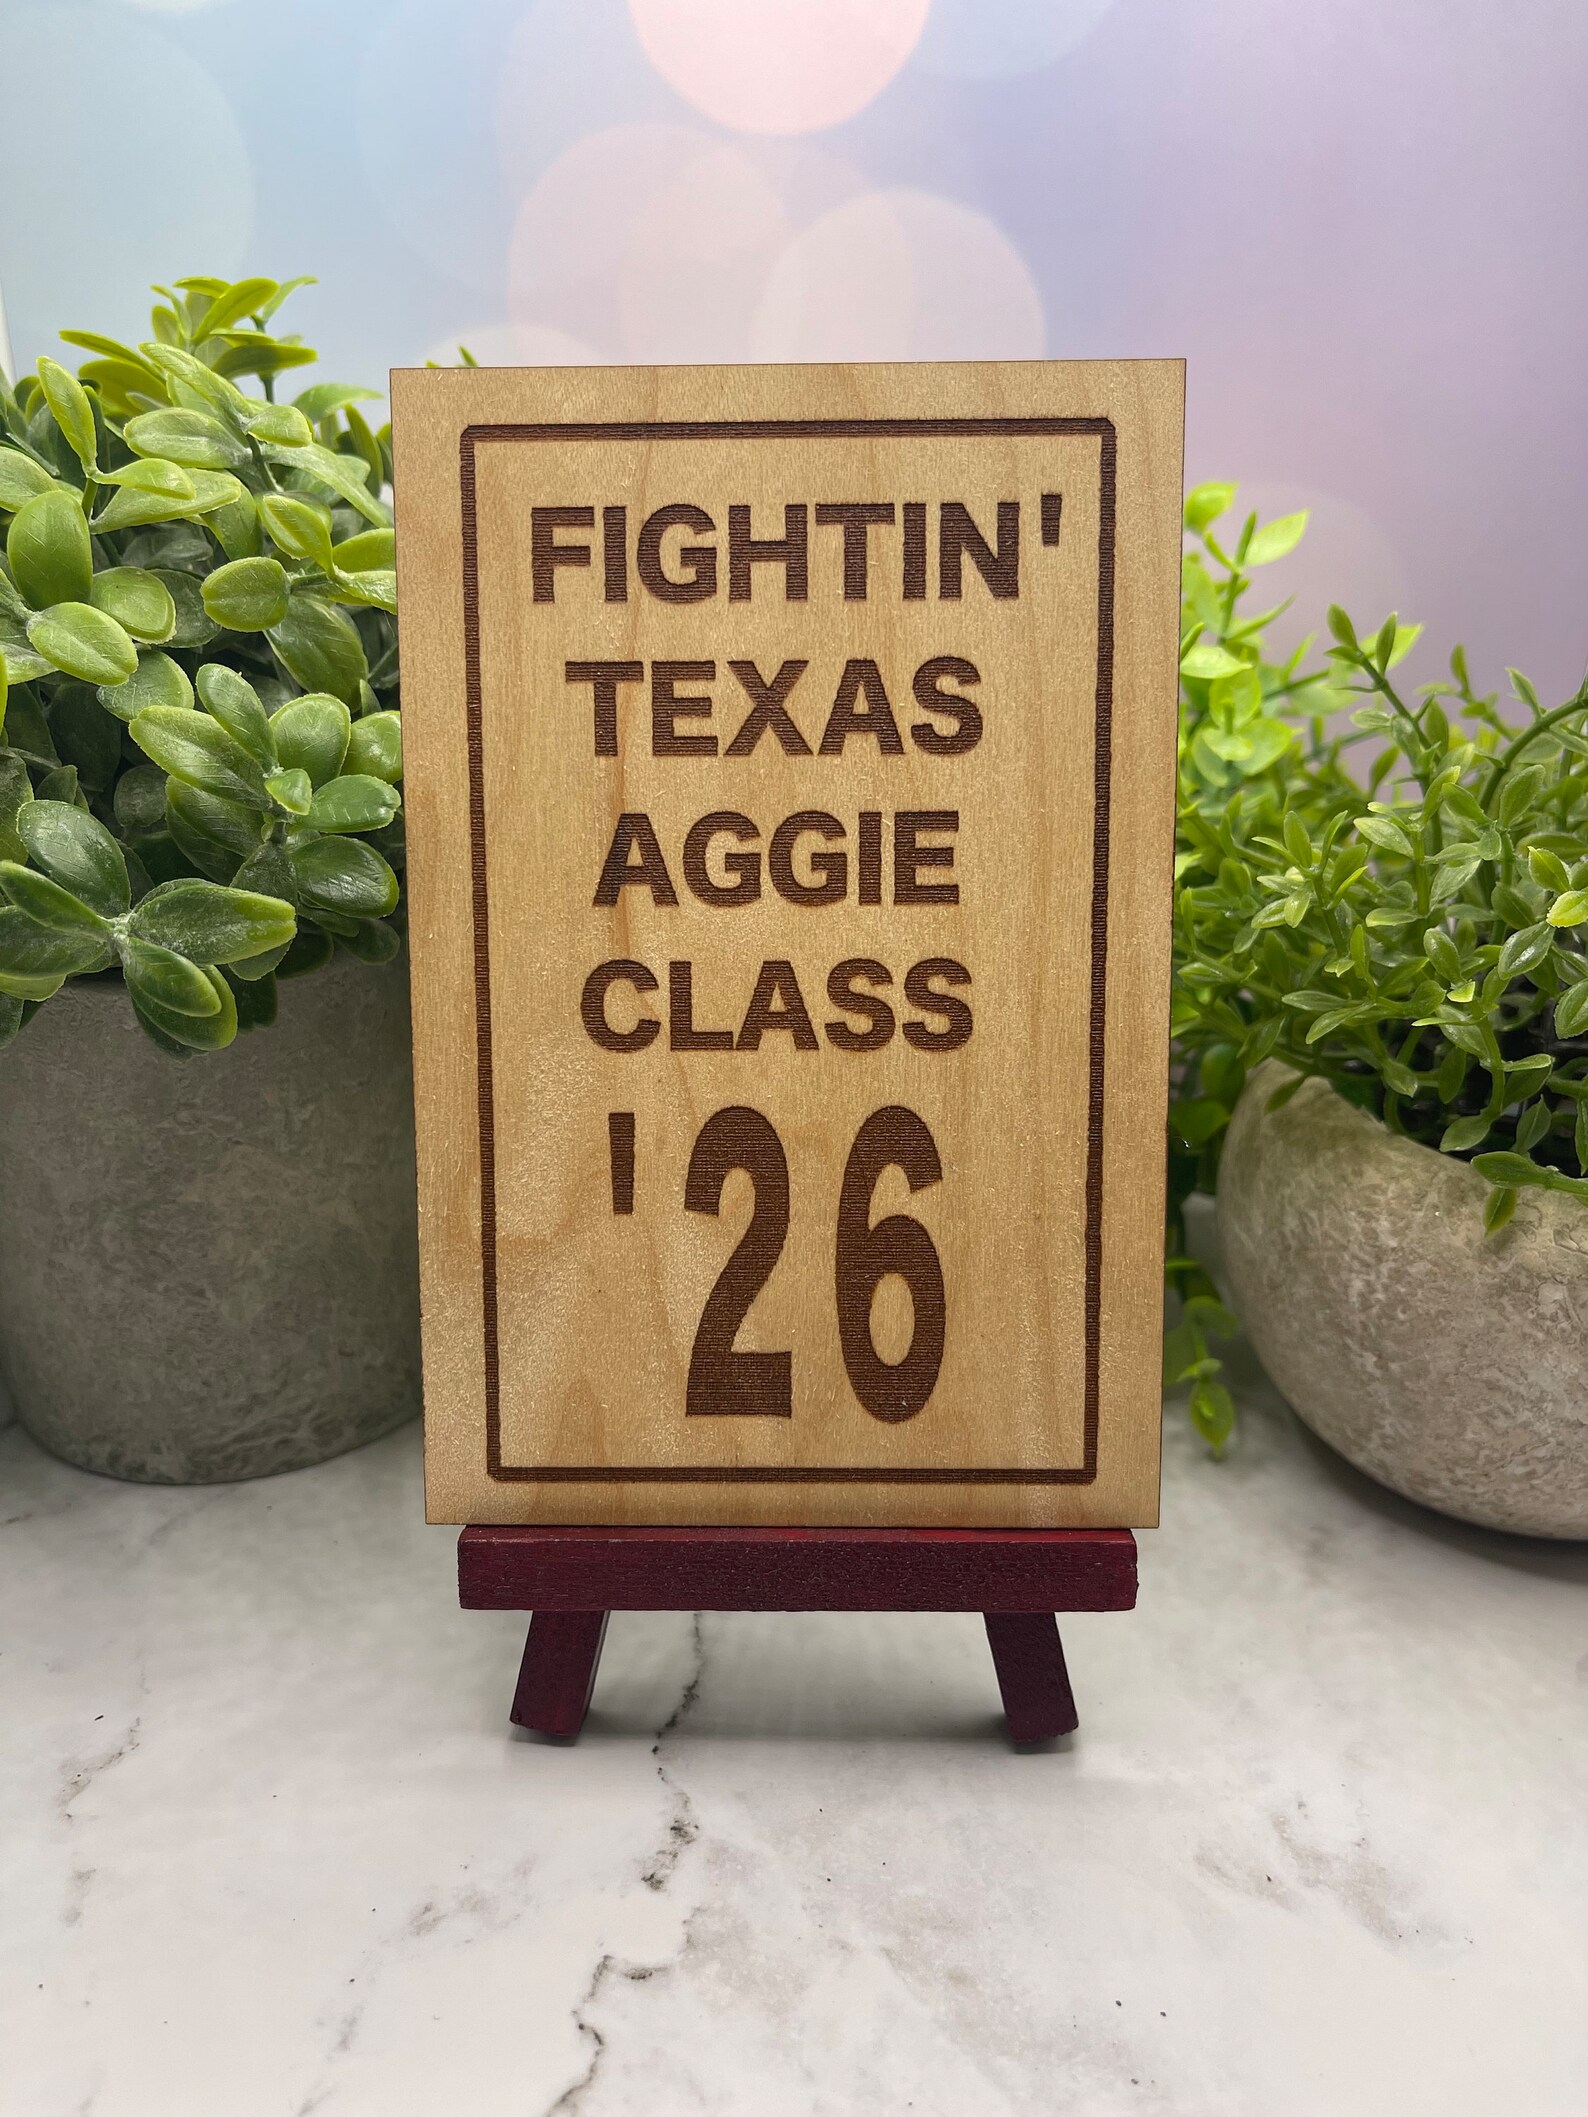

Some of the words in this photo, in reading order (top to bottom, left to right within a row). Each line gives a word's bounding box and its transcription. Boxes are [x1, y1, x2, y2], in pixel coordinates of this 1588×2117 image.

[530, 493, 1064, 605] FIGHTIN'
[564, 655, 984, 758] TEXAS
[592, 810, 960, 909] AGGIE
[580, 957, 974, 1054] CLASS
[608, 1105, 948, 1426] '26
